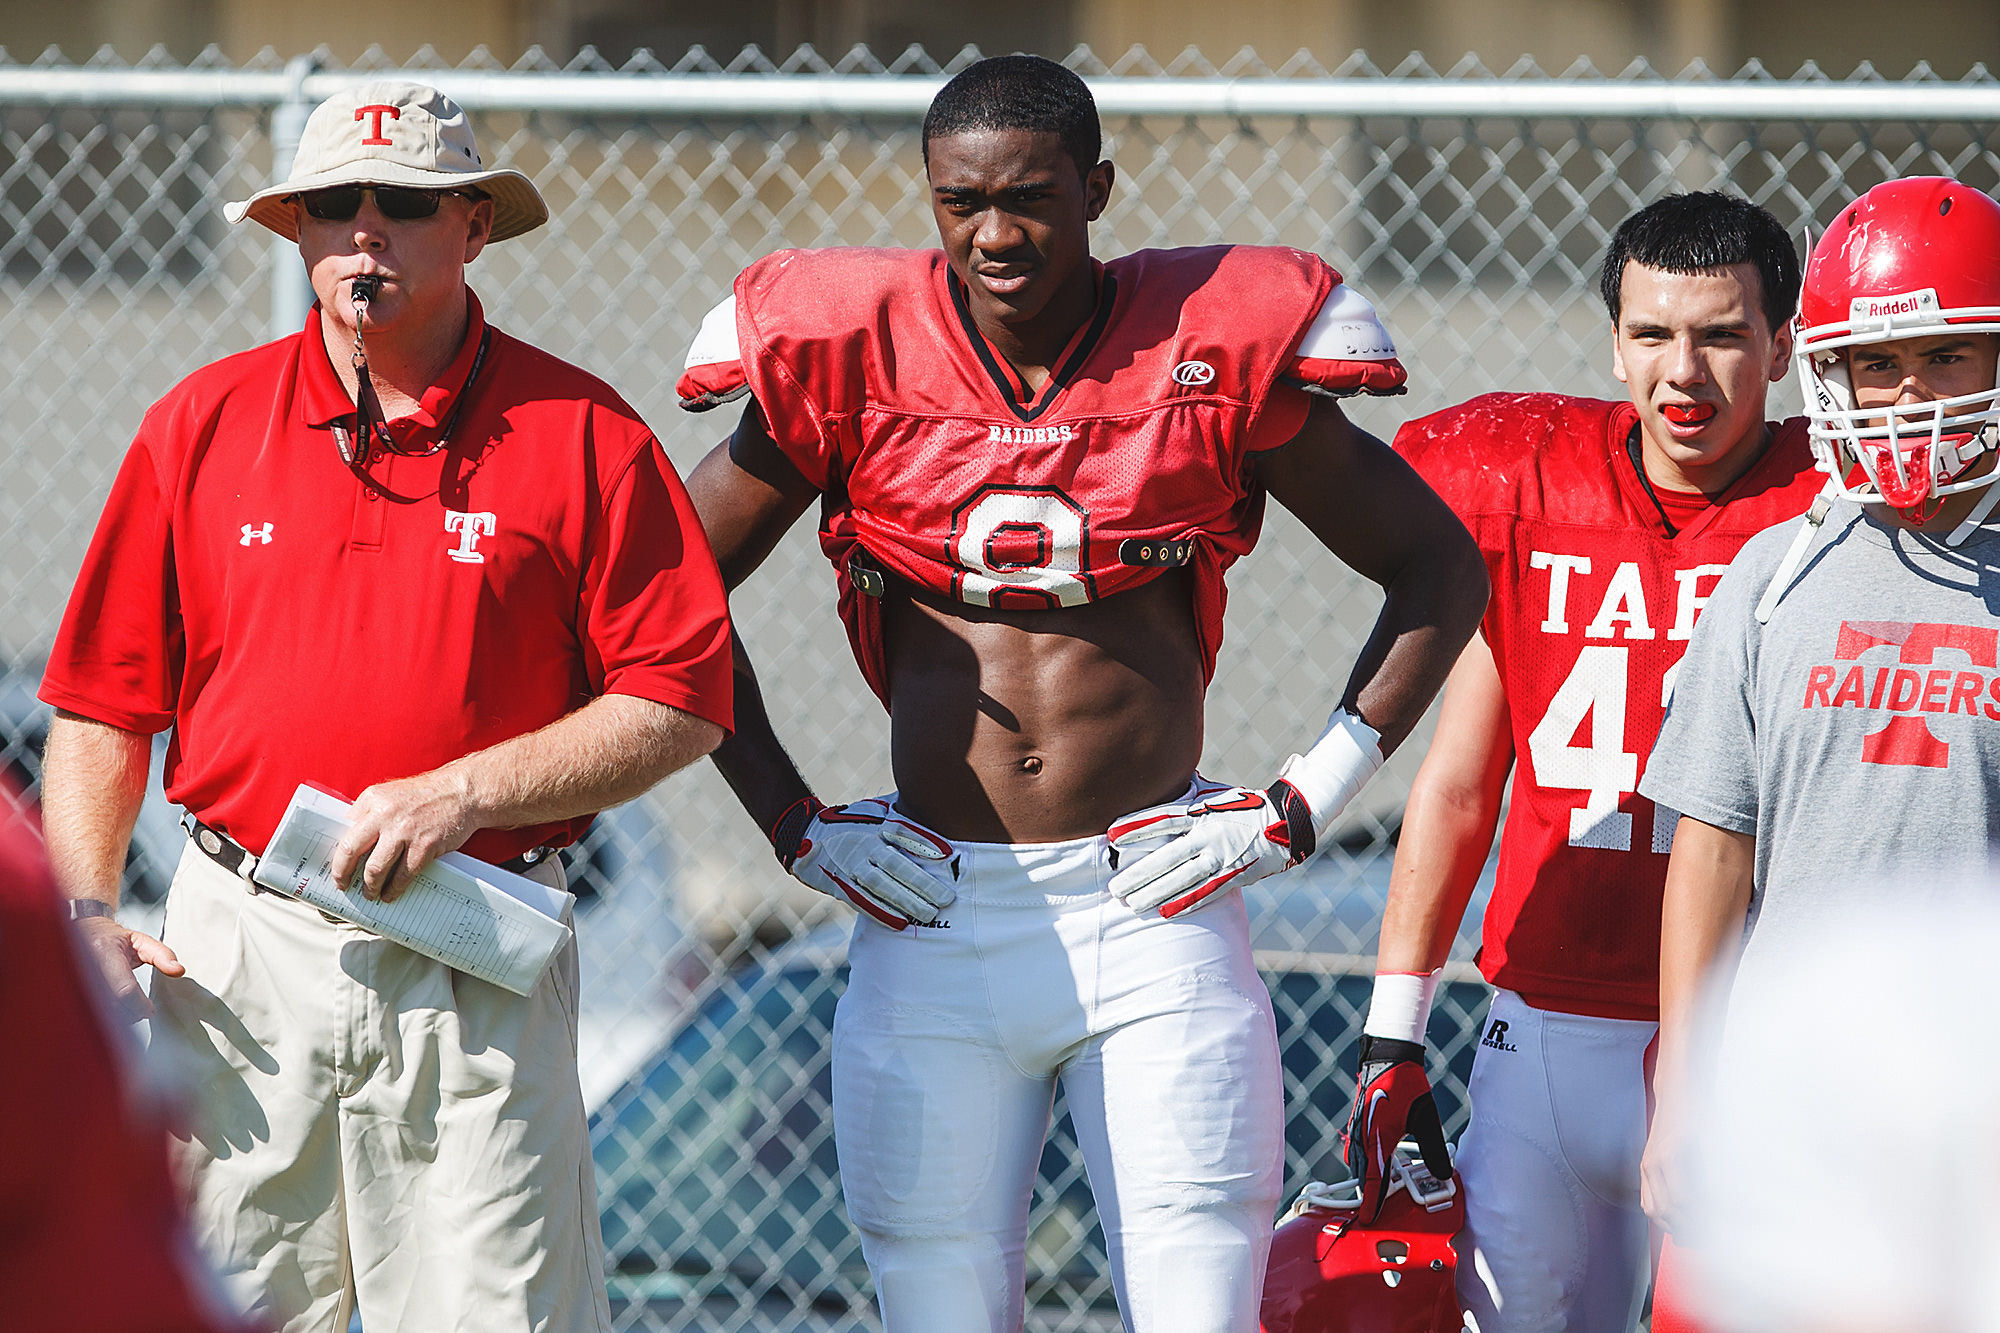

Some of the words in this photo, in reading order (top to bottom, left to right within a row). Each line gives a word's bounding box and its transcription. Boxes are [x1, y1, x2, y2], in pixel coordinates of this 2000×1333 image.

[354, 104, 400, 145] T
[1869, 298, 1919, 317] Riddell
[988, 425, 1073, 444] RAIDERS
[444, 509, 496, 564] T
[1834, 620, 1999, 768] T
[1528, 645, 1685, 854] 4
[1487, 1019, 1509, 1042] R
